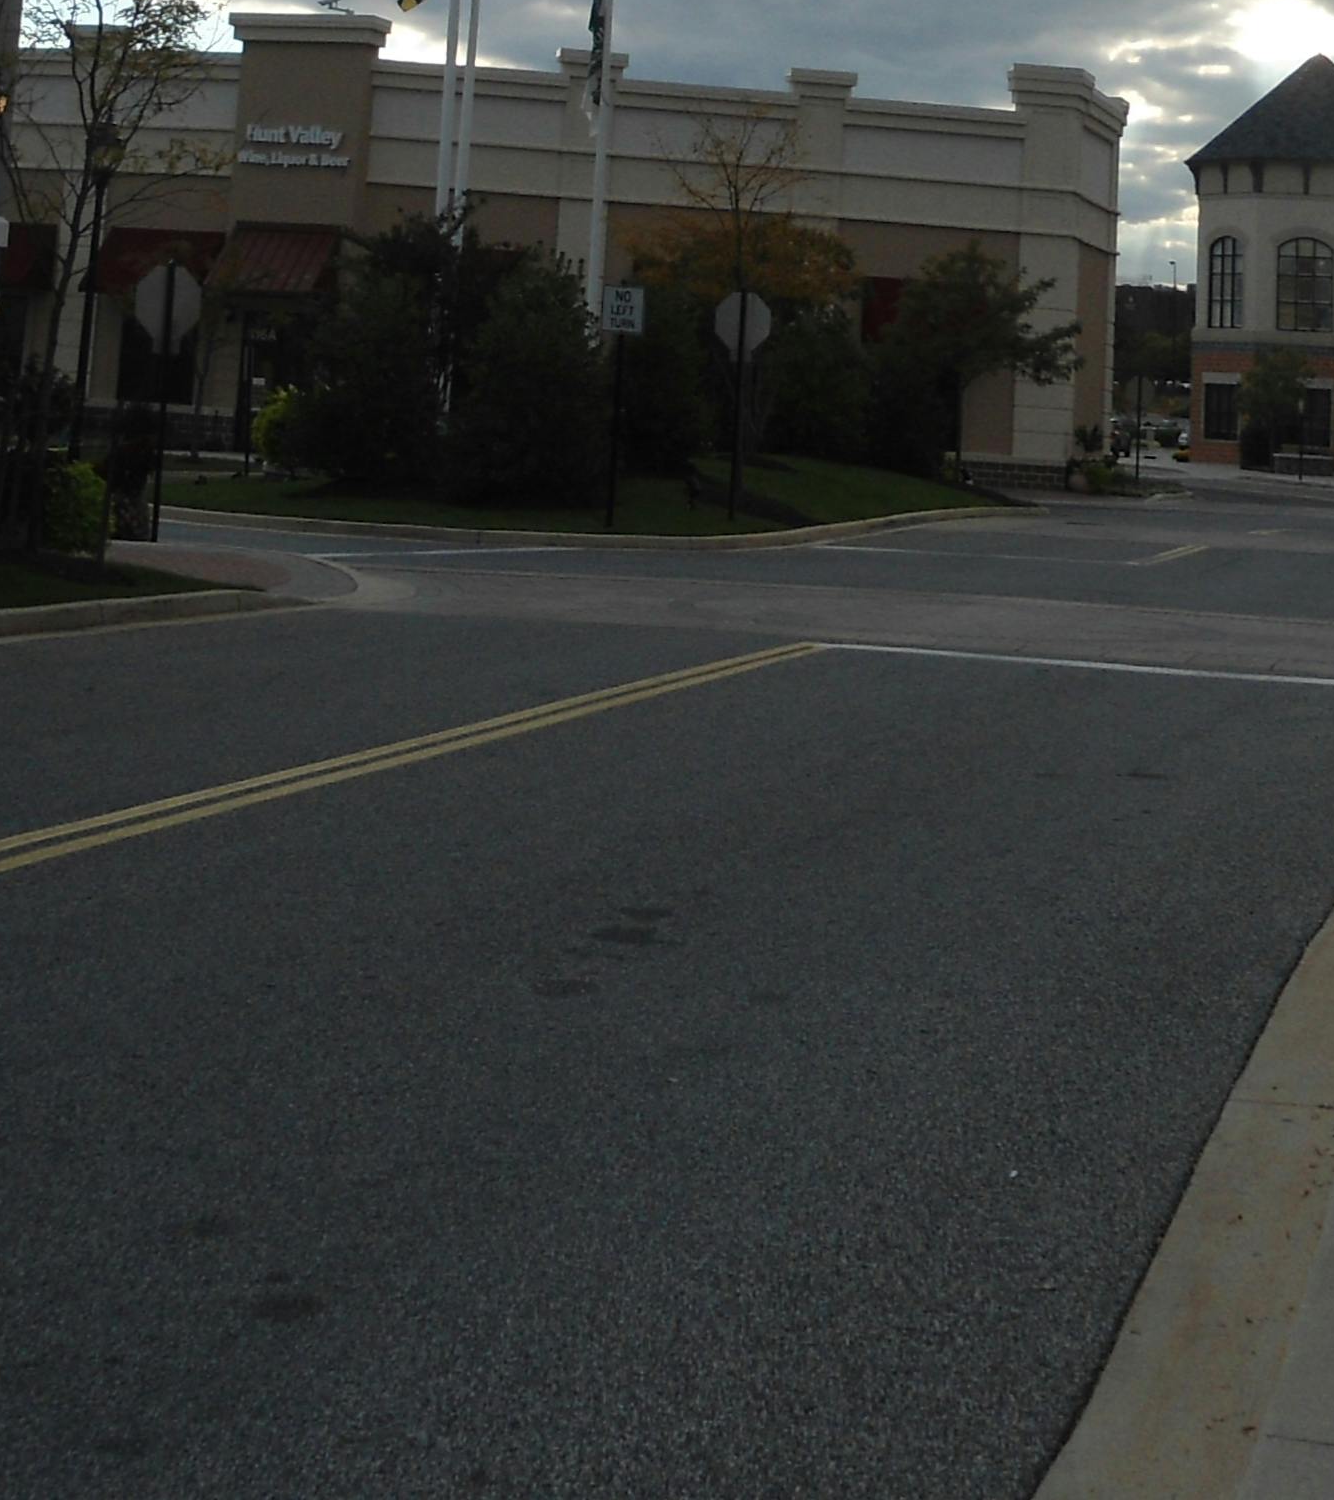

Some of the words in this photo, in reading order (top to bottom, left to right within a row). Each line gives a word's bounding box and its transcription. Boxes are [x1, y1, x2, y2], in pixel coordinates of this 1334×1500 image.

[247, 124, 286, 144] Hunt
[289, 125, 345, 150] Valley
[271, 151, 307, 168] Liquor
[308, 153, 319, 166] &
[321, 154, 350, 166] Beer
[615, 290, 632, 303] NO
[611, 304, 635, 316] LEFT
[611, 317, 636, 329] TURN
